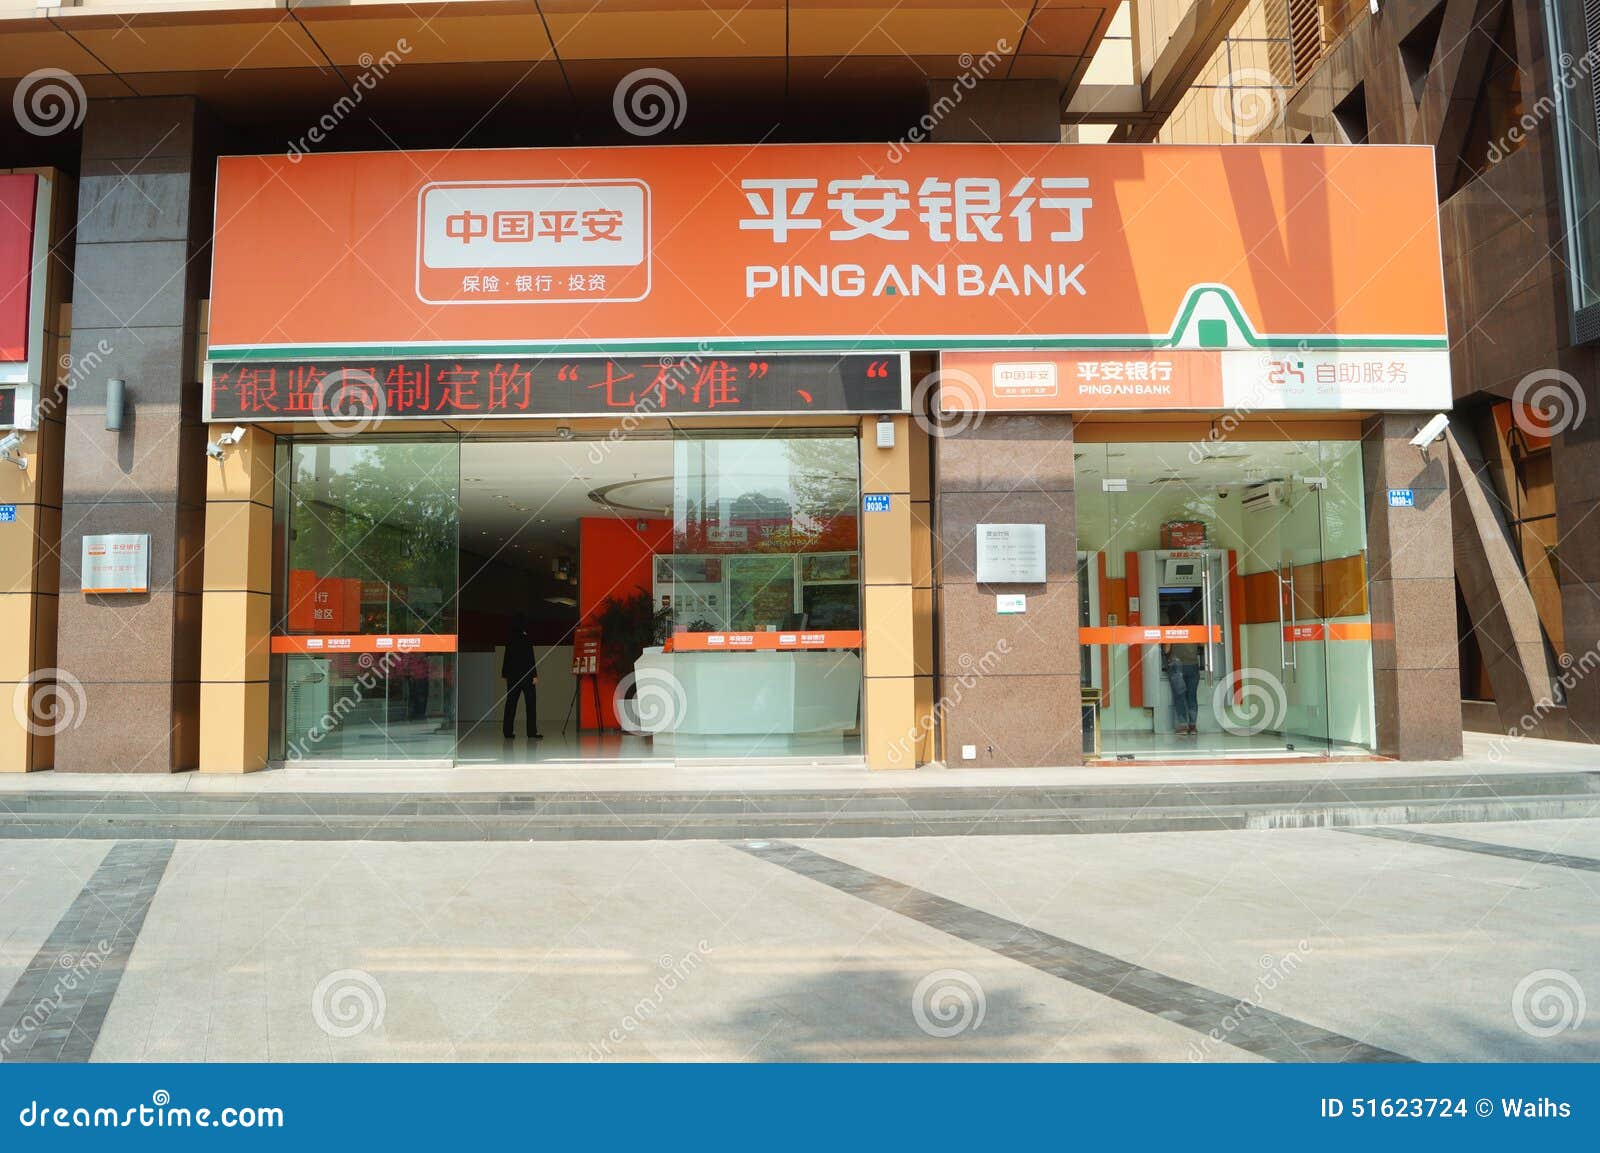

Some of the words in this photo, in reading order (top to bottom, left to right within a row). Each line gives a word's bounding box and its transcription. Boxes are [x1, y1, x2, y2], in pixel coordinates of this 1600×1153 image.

[739, 175, 1093, 243] 平安银行
[446, 208, 623, 244] 中国平安
[1077, 361, 1172, 381] 平安银行
[1316, 361, 1409, 384] 自助服务
